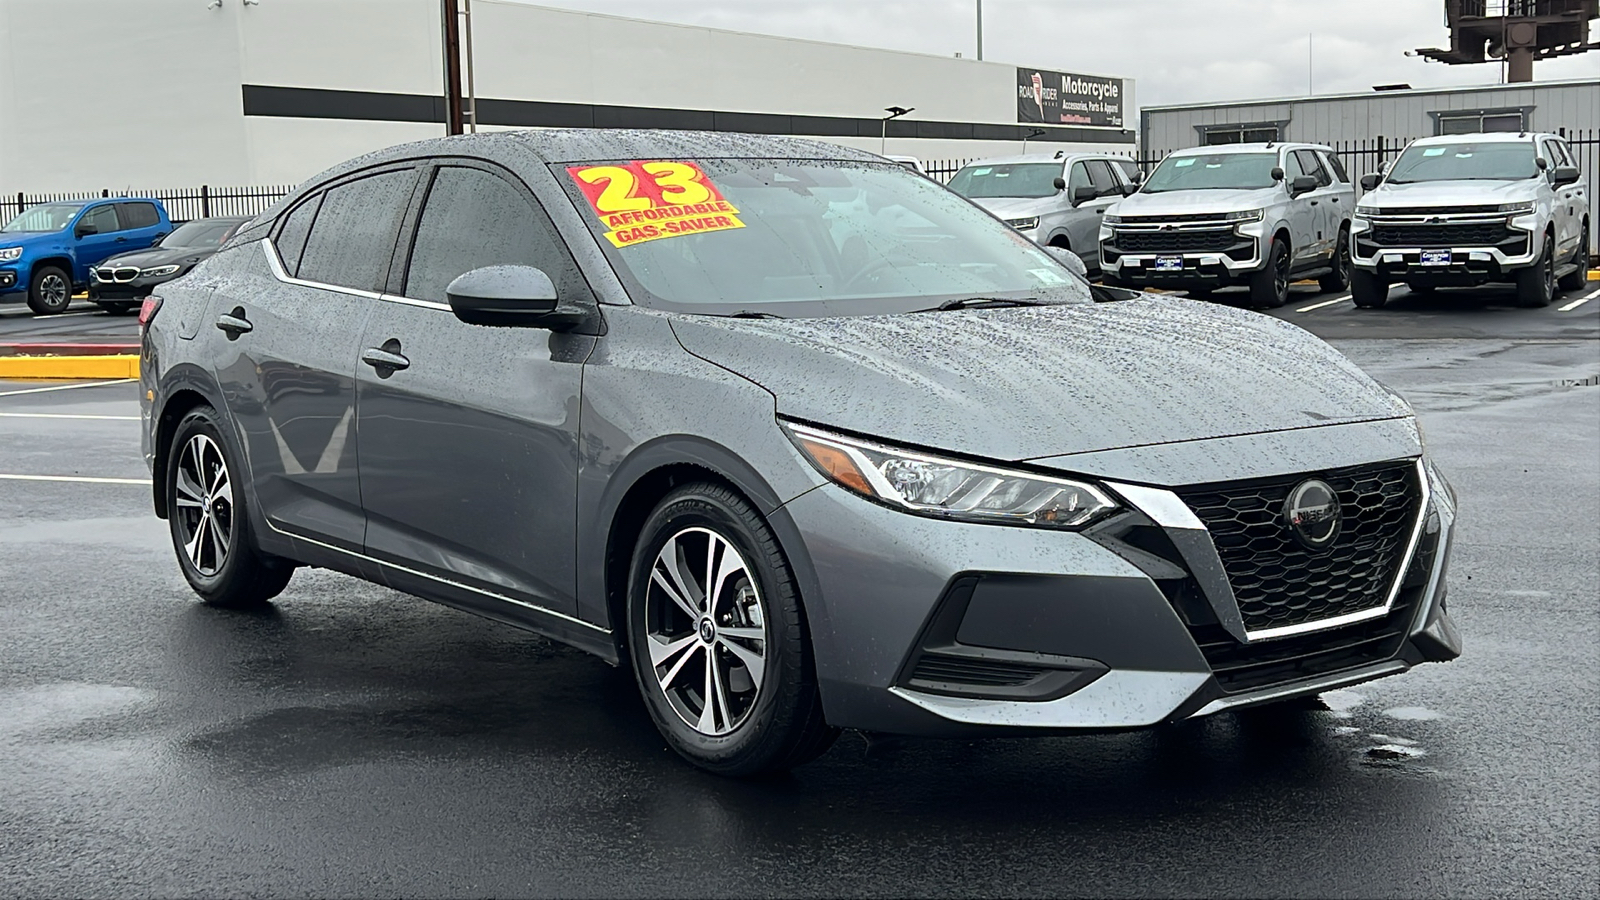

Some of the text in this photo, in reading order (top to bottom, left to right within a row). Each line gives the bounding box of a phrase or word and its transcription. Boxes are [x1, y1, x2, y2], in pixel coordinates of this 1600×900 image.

[1019, 85, 1058, 100] ROAD RIDER
[1061, 75, 1118, 100] Motorcycle
[1089, 101, 1099, 112] Parts
[577, 161, 713, 212] 23
[608, 201, 731, 228] AFFORDABLE
[615, 216, 733, 243] GAS-SAVER
